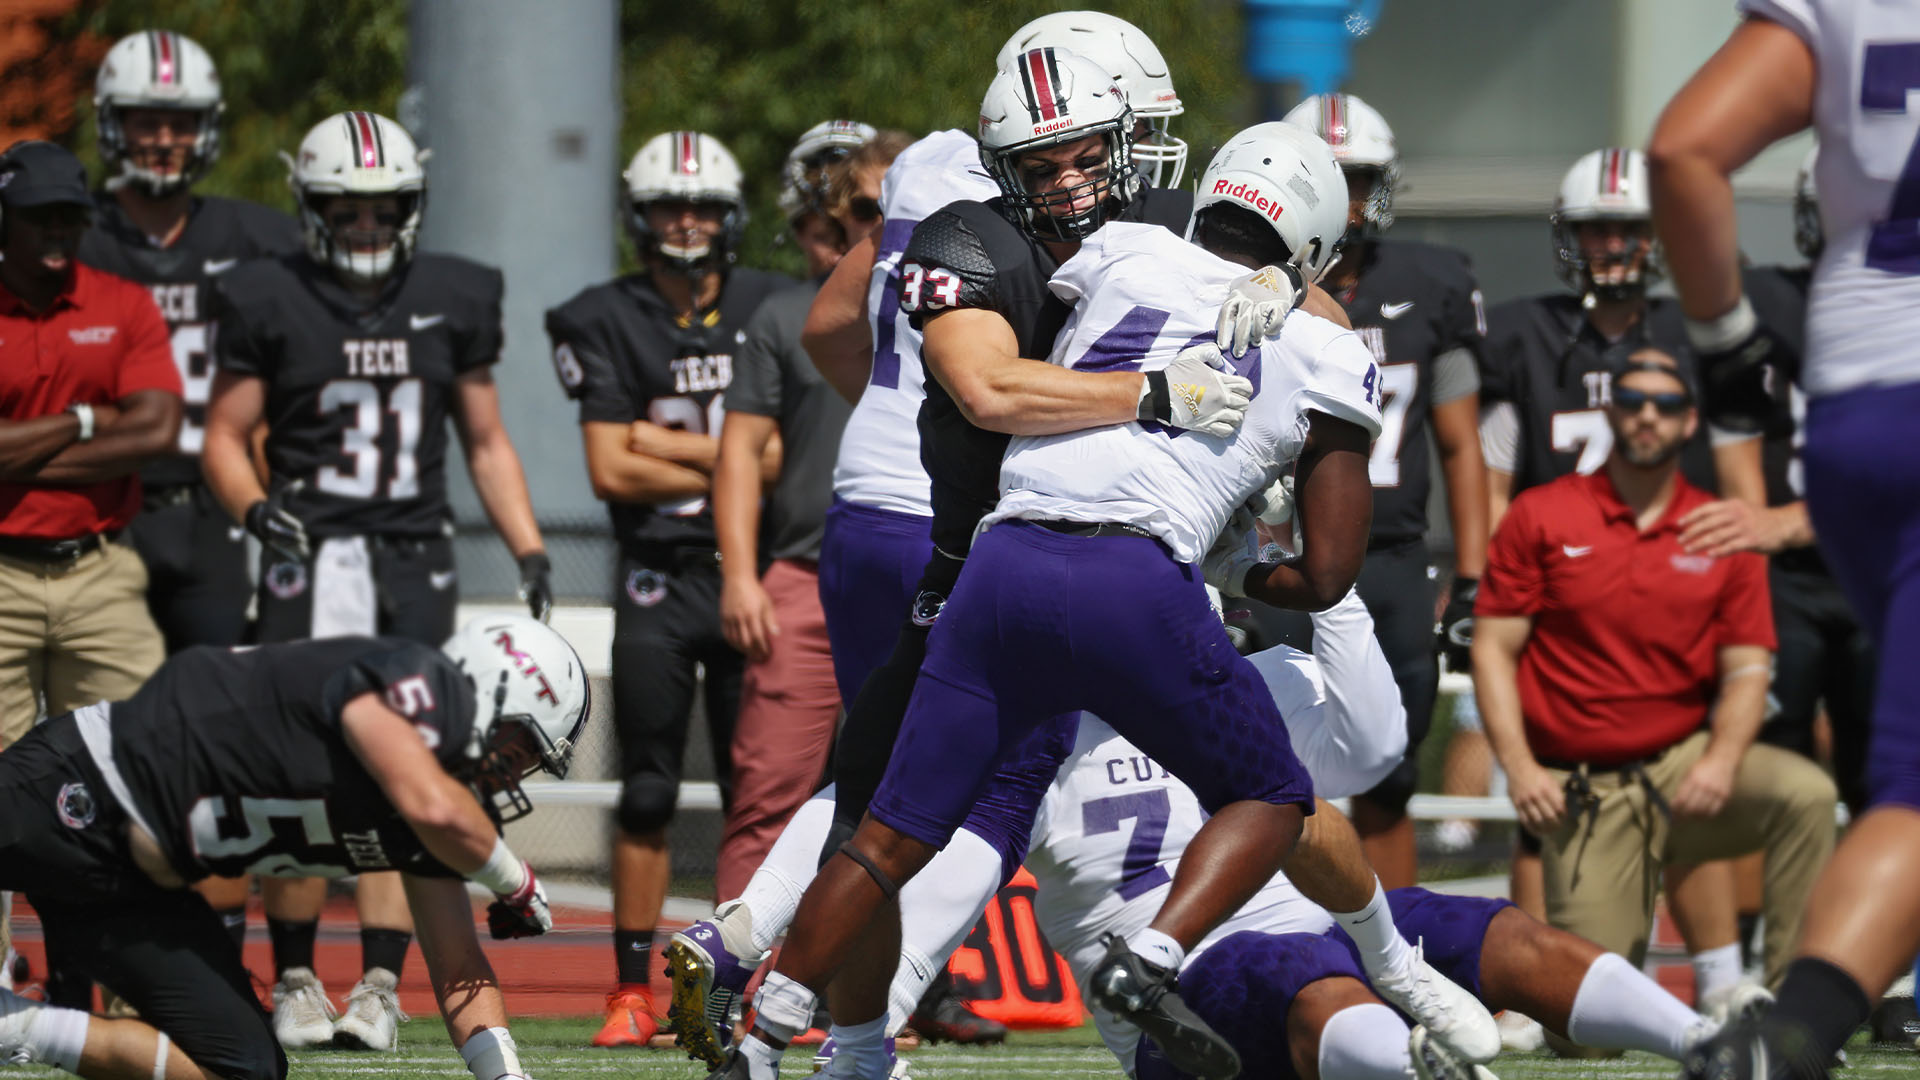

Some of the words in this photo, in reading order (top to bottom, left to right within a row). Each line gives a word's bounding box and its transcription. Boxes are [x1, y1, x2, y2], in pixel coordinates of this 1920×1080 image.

[1034, 119, 1073, 136] Riddell
[1202, 179, 1284, 222] Riddell
[151, 284, 198, 322] ECH
[901, 260, 962, 312] 33
[343, 338, 409, 376] TECH
[670, 355, 733, 393] TECH
[318, 378, 425, 500] 31
[1368, 362, 1418, 487] 7
[1550, 409, 1615, 477] 7
[494, 631, 560, 708] MIT
[1081, 787, 1172, 904] 7
[695, 928, 714, 941] 3
